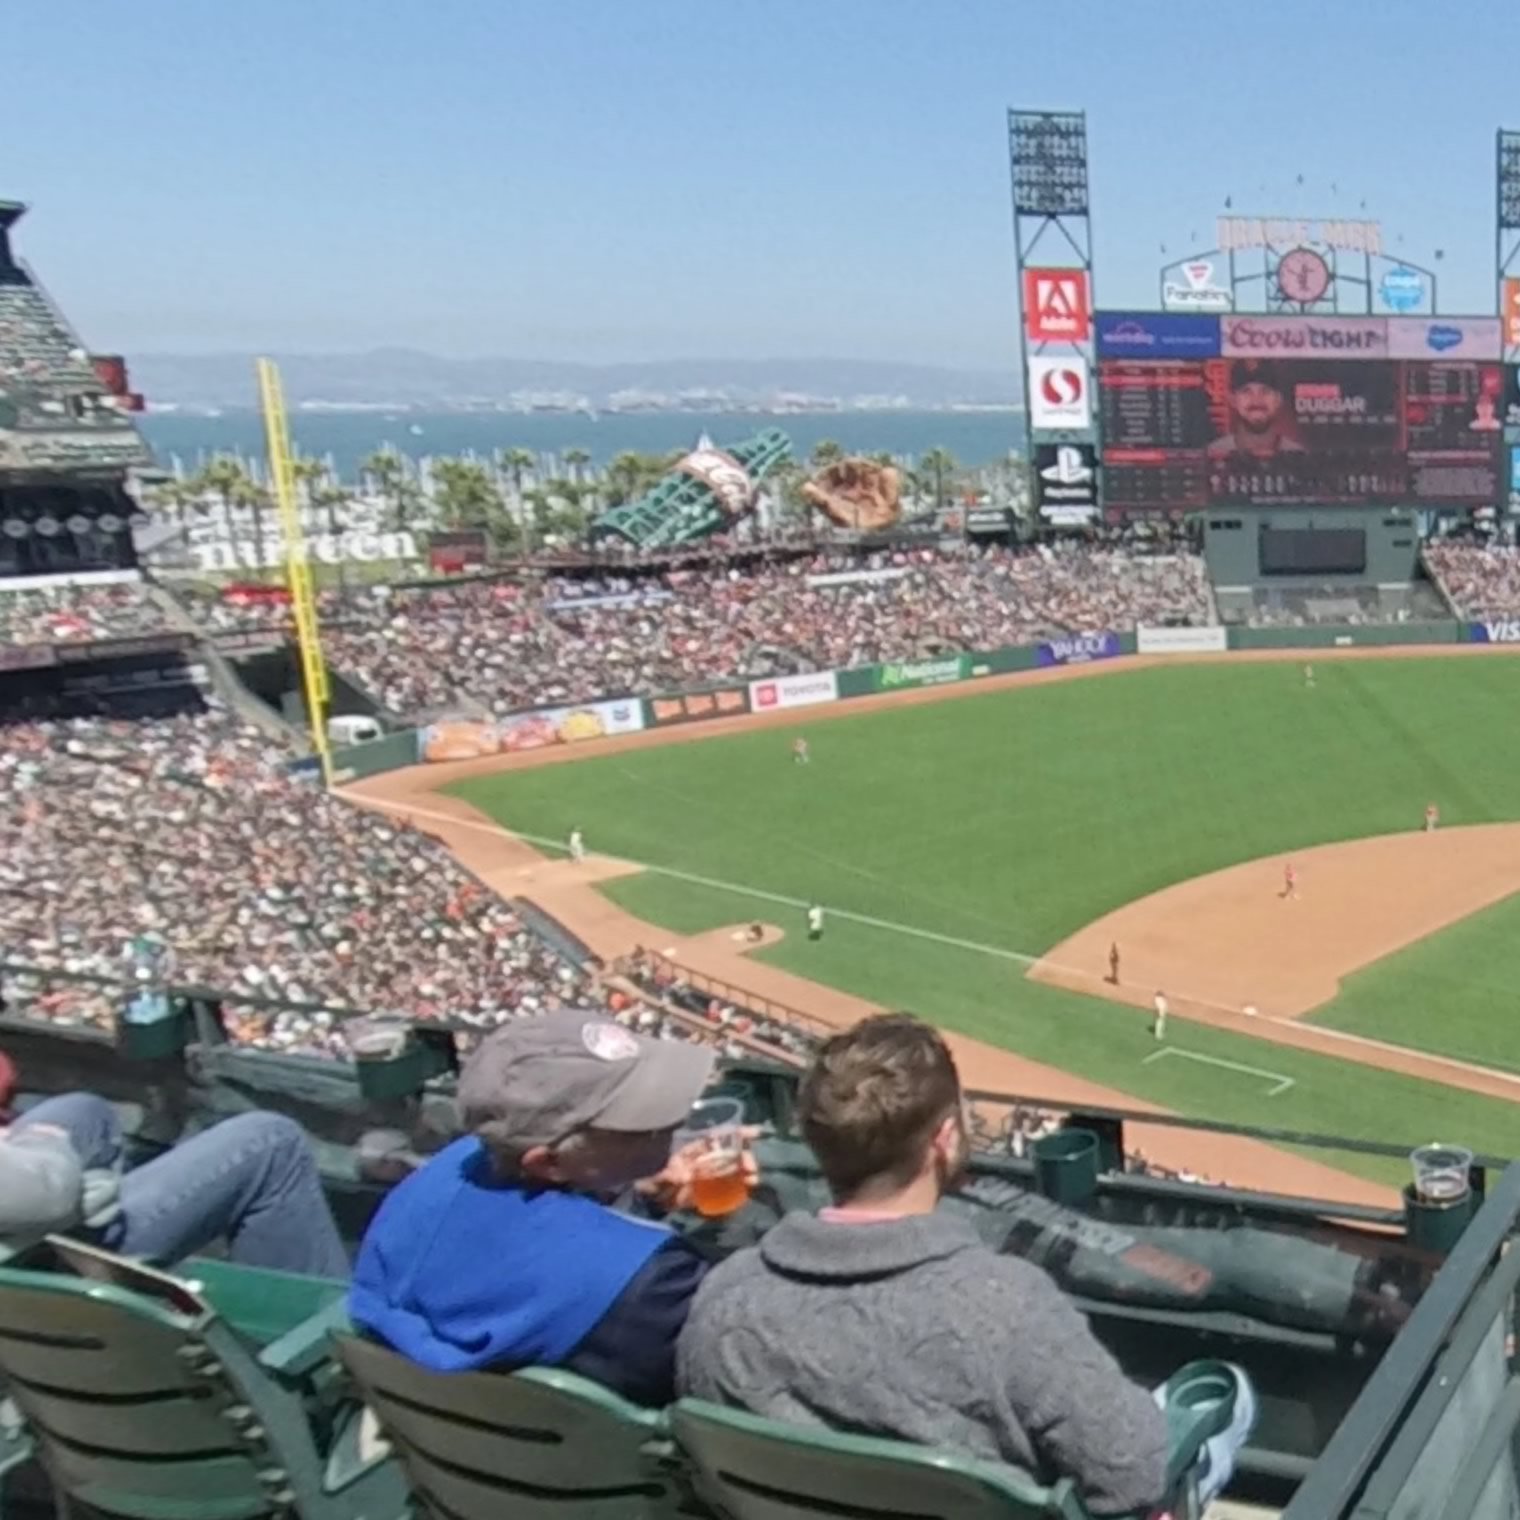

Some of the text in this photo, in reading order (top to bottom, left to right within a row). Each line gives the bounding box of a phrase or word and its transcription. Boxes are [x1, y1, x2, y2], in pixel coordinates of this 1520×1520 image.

[1166, 285, 1233, 303] Fanatics
[1295, 396, 1368, 414] DUGGAR
[783, 681, 832, 697] TOYOTA
